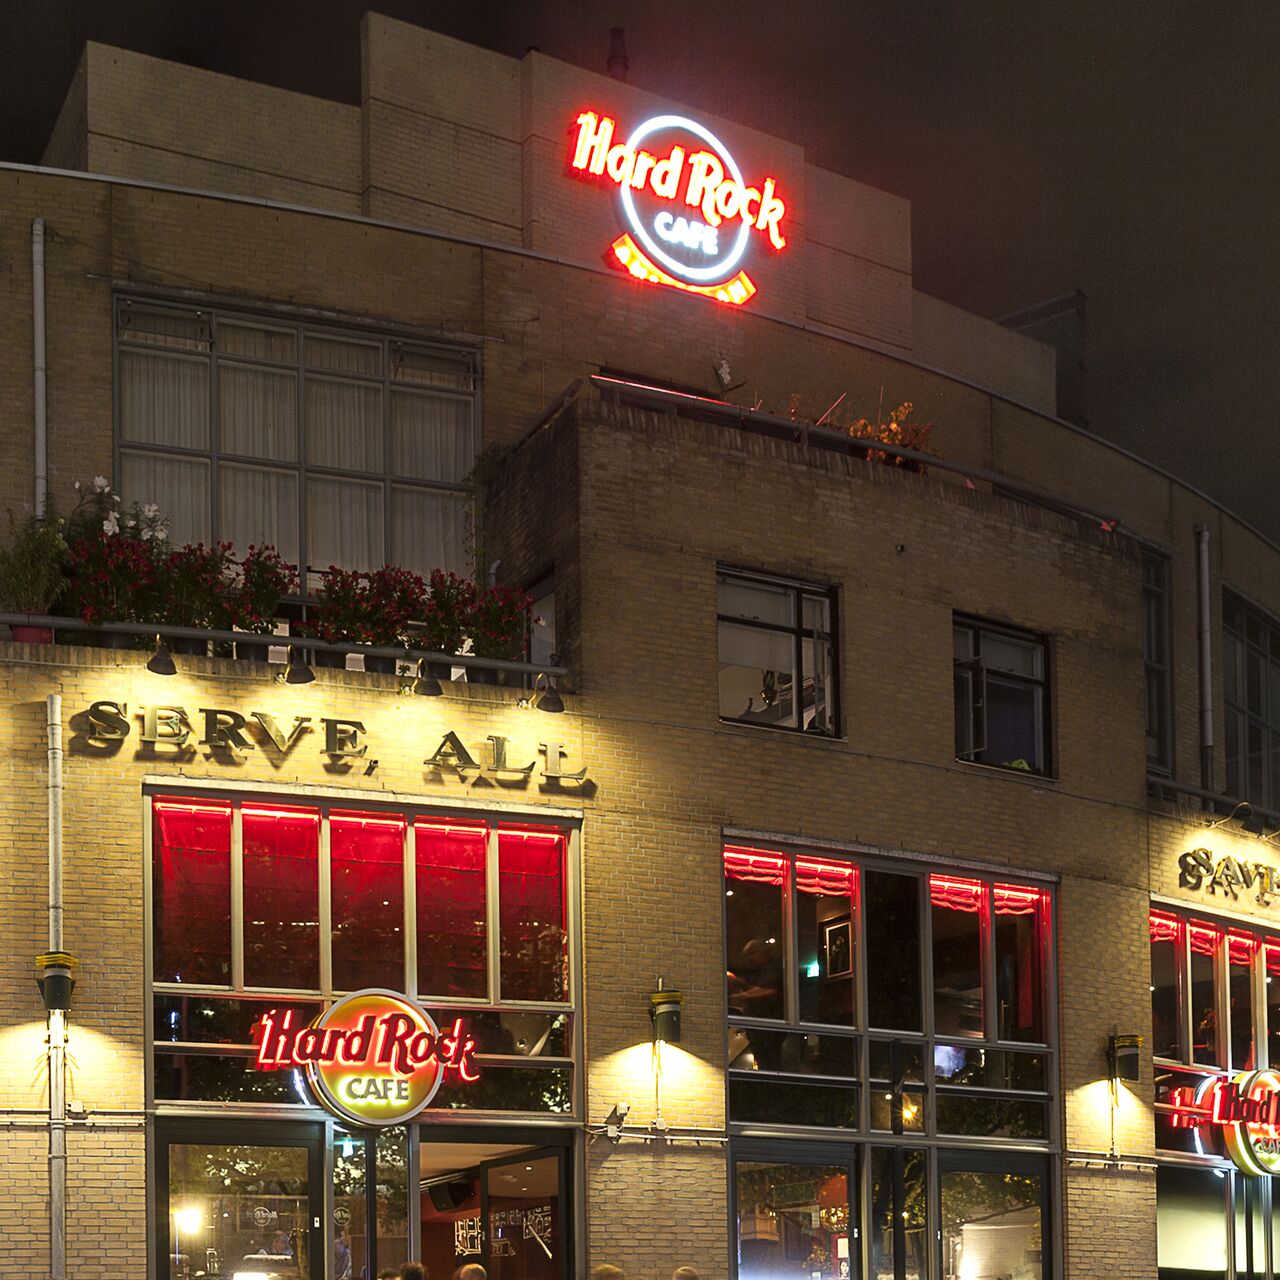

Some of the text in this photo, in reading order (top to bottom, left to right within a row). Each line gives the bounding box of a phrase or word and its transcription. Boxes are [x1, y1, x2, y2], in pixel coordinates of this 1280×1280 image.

[572, 112, 786, 250] Hard Rock
[654, 211, 718, 255] CAFE
[88, 701, 588, 781] SERVE, ALL
[257, 1009, 480, 1081] Hard Rock
[346, 1078, 409, 1100] CAFE
[1219, 1082, 1272, 1125] Hard
